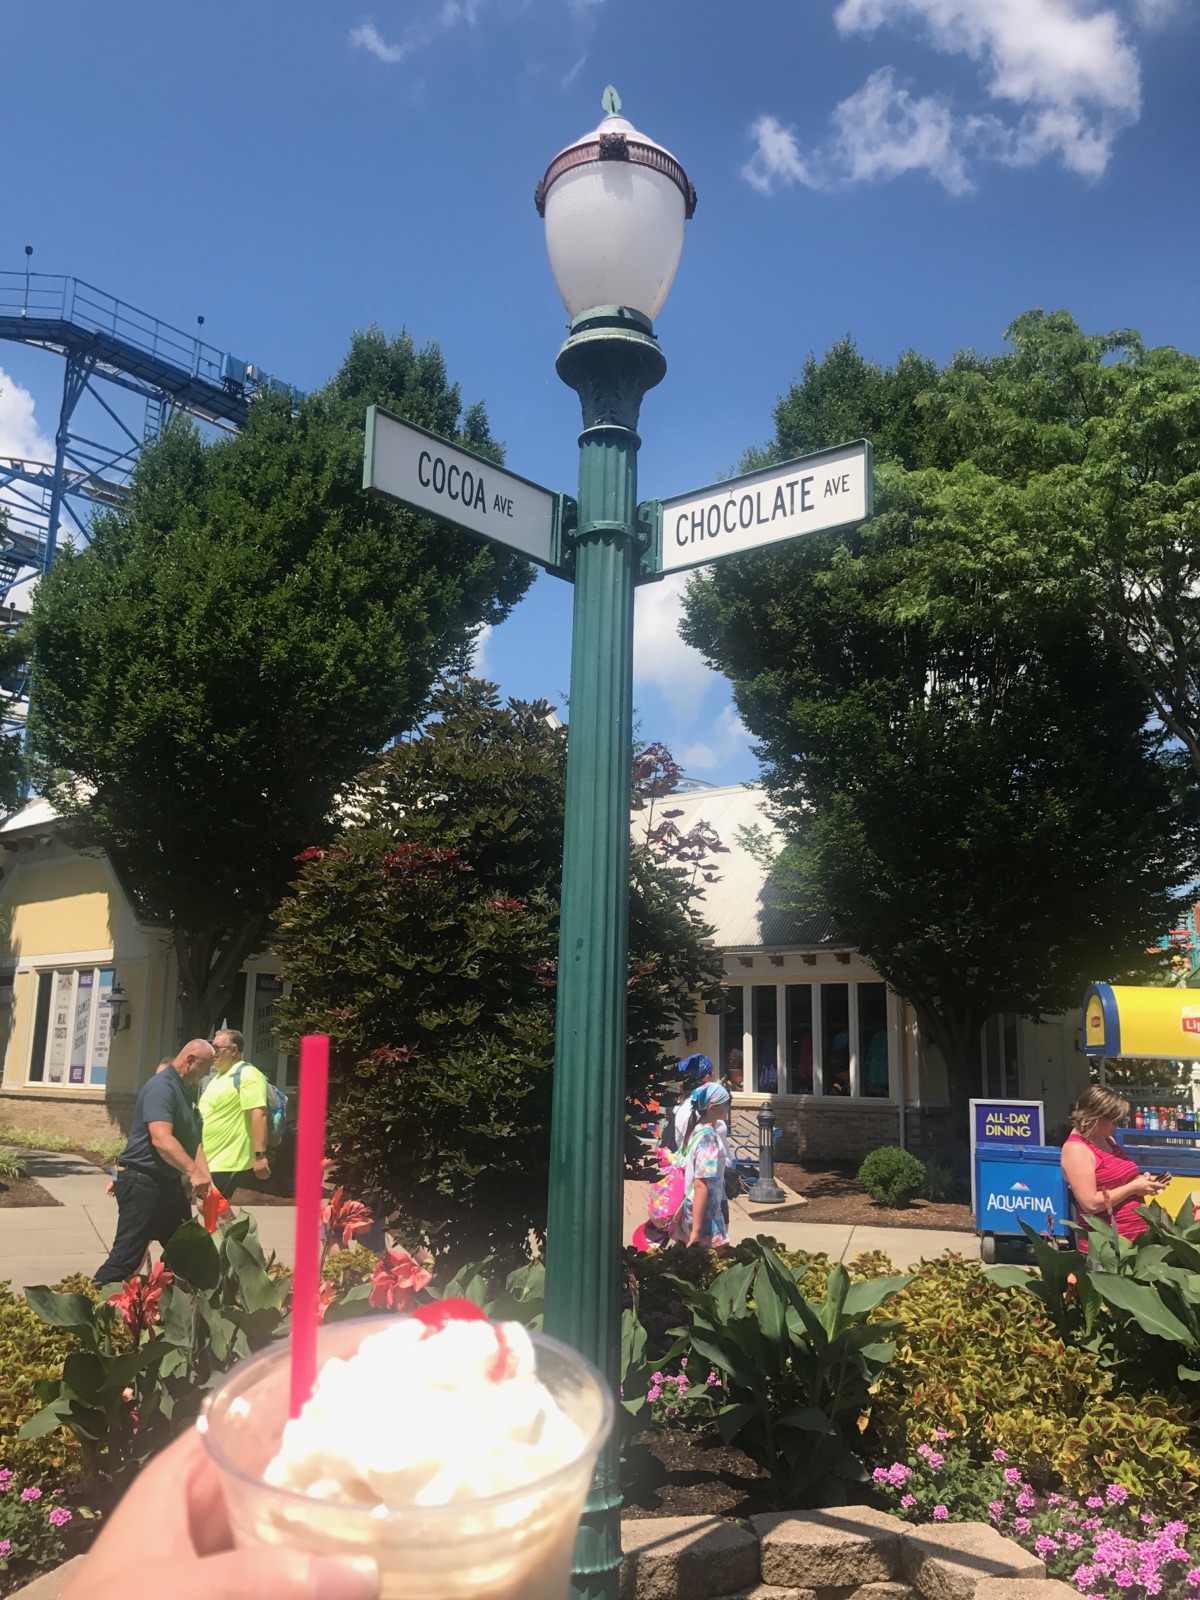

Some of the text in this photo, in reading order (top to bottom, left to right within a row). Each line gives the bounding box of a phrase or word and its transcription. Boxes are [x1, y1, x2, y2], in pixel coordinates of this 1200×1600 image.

[418, 451, 514, 518] COCOA AVE
[676, 474, 850, 547] CHOCOLATE AVE
[77, 998, 90, 1017] GAMES
[57, 1013, 66, 1025] MEAL
[74, 1032, 87, 1051] BOOKS
[985, 1112, 1031, 1124] ALL-DAY
[985, 1125, 1032, 1137] DINING
[987, 1192, 1055, 1213] AQUAFINA
